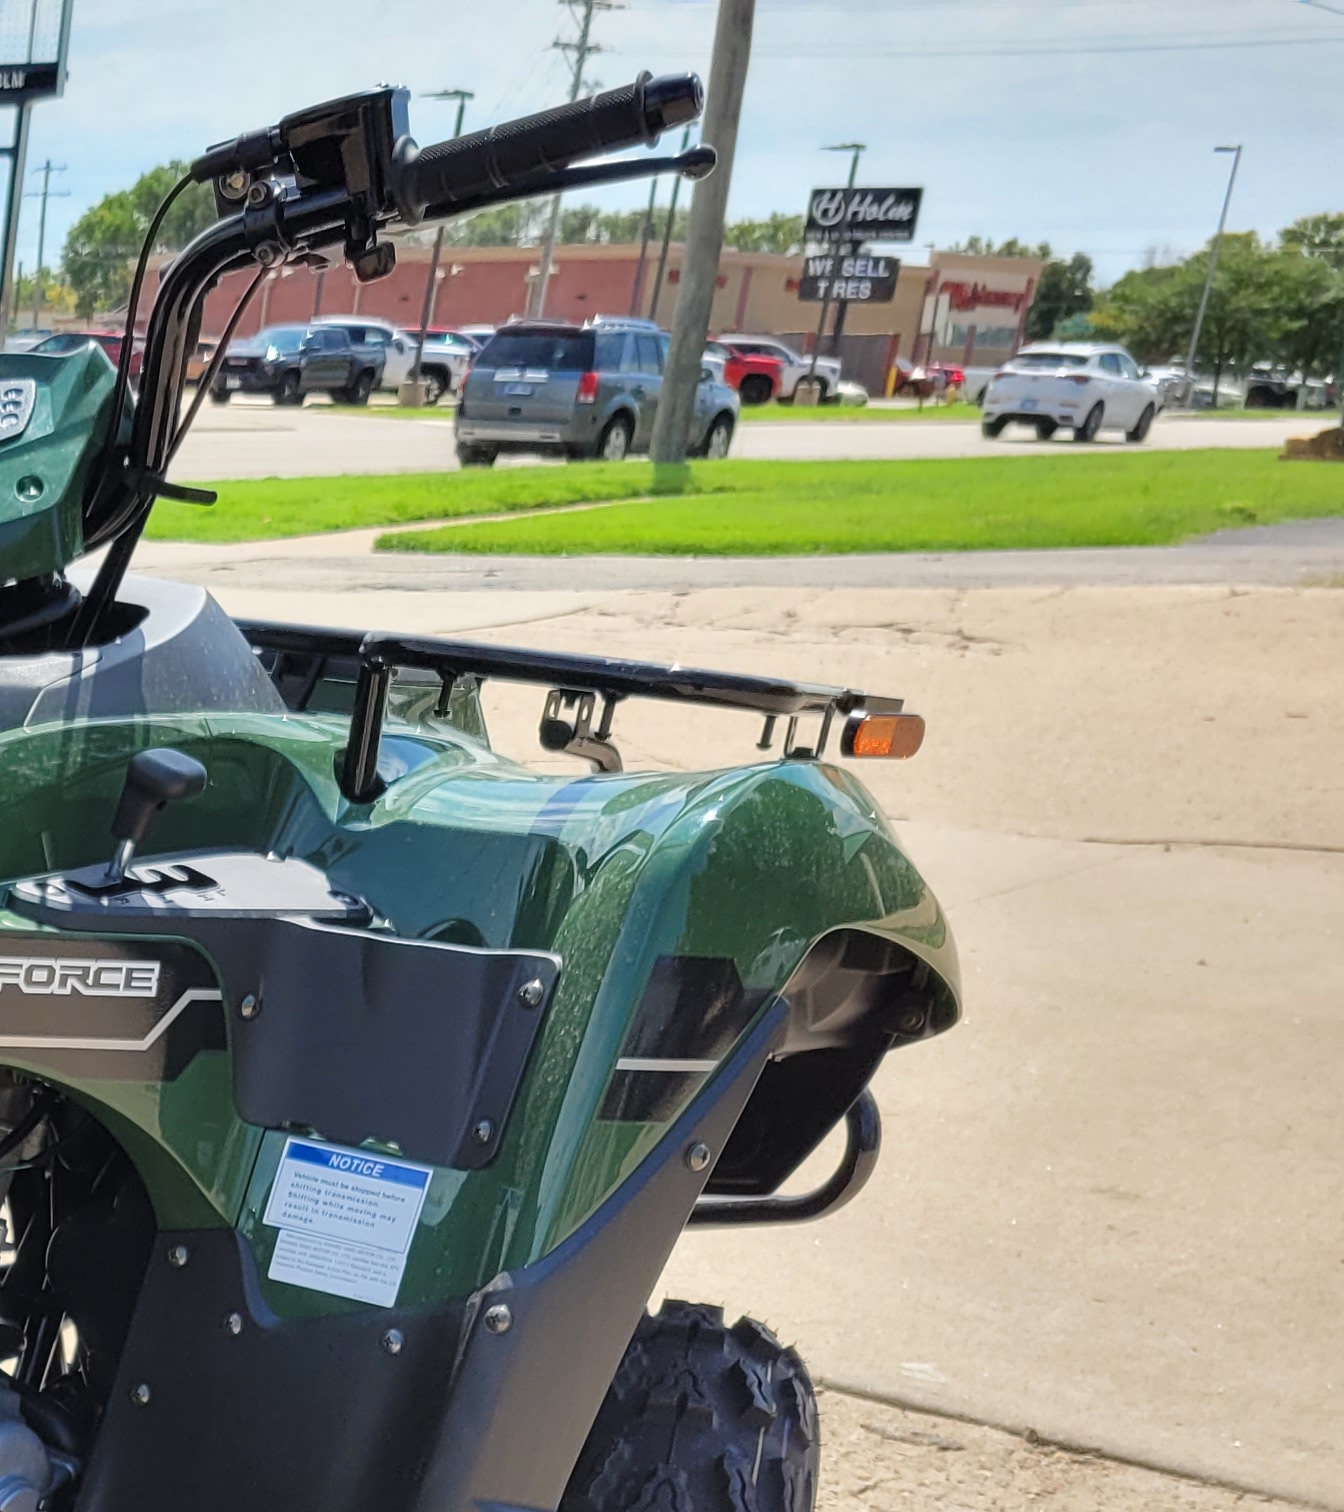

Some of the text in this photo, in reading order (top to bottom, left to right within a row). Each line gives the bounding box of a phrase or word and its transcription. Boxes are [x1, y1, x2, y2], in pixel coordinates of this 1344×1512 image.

[847, 192, 914, 222] Holm
[841, 257, 890, 278] SELL
[817, 278, 872, 300] TRES
[328, 1153, 384, 1178] NOTICE
[290, 1180, 322, 1195] shifting
[294, 1171, 318, 1182] Vehicle
[320, 1177, 338, 1187] must
[350, 1184, 380, 1199] stopped
[382, 1191, 405, 1203] before
[284, 1200, 308, 1212] result
[321, 1209, 375, 1228] transmission
[287, 1191, 396, 1223] Shifting while moving may
